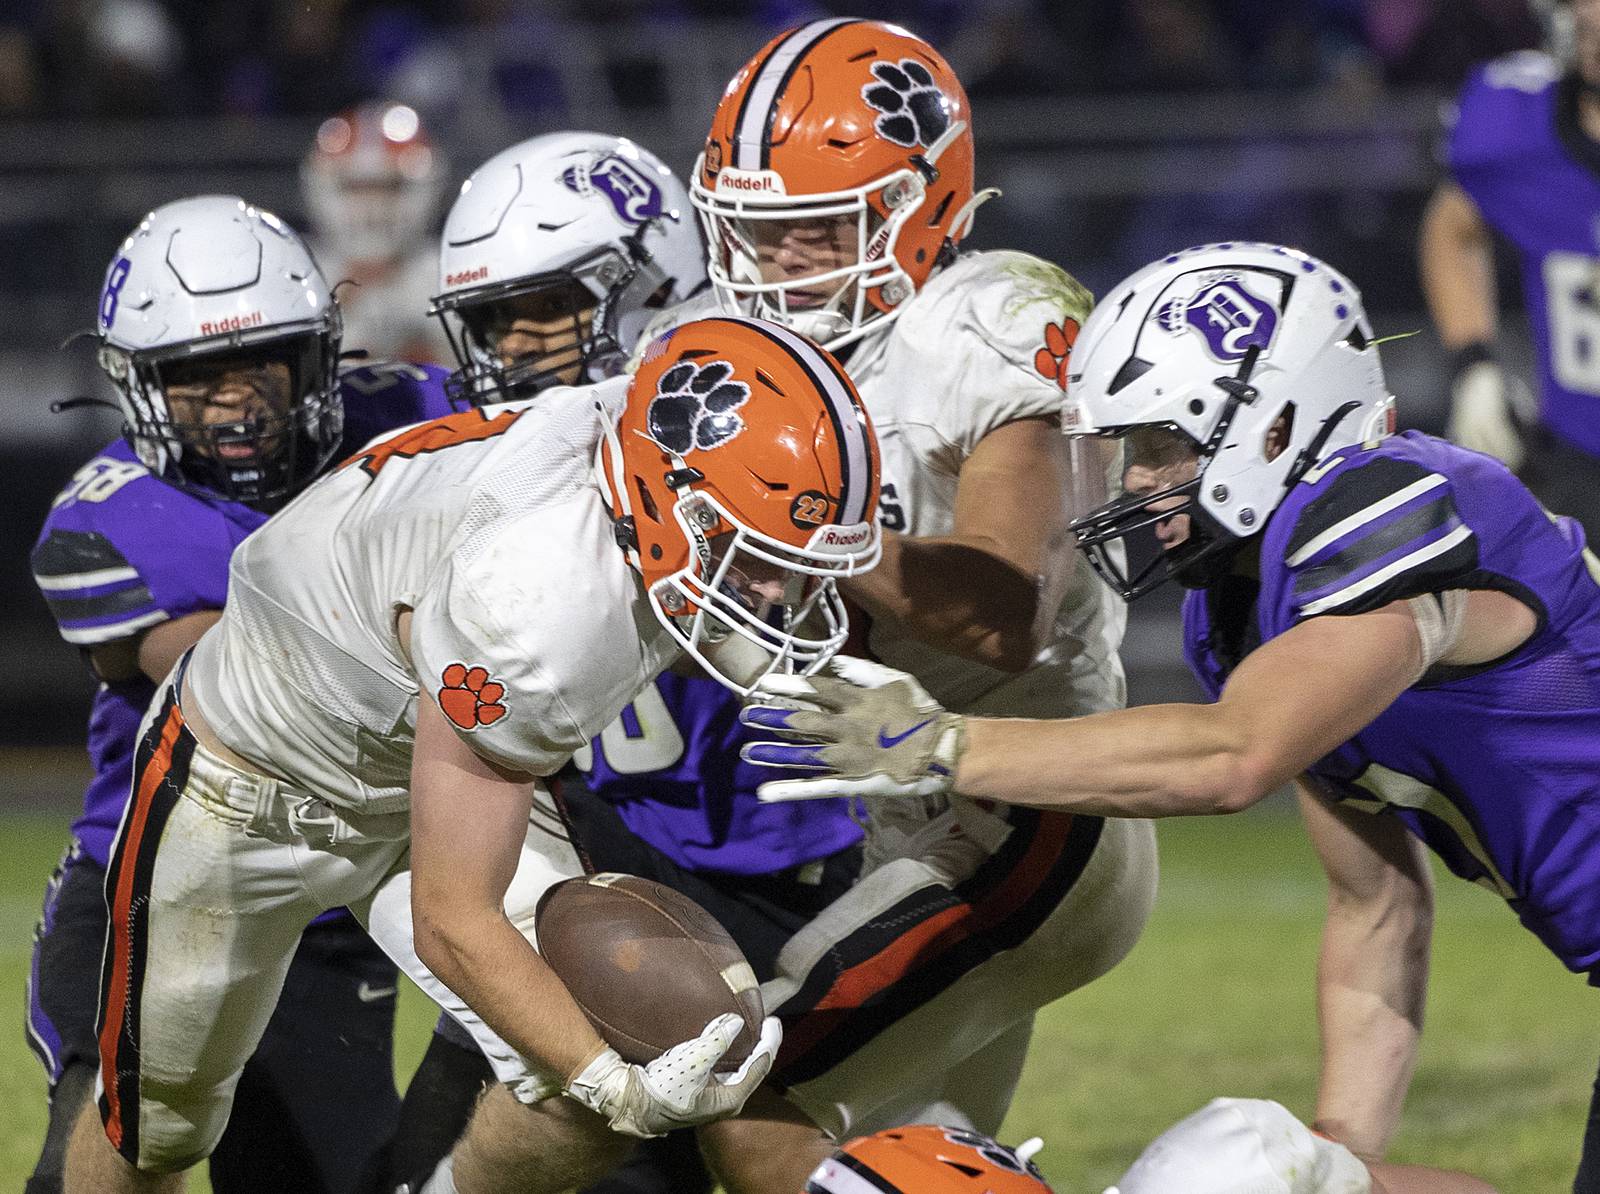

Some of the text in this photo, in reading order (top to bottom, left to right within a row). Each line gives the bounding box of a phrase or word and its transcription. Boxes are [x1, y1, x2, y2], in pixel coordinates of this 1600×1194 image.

[722, 174, 772, 190] Riddell
[201, 310, 263, 336] Riddell
[794, 494, 829, 525] 22
